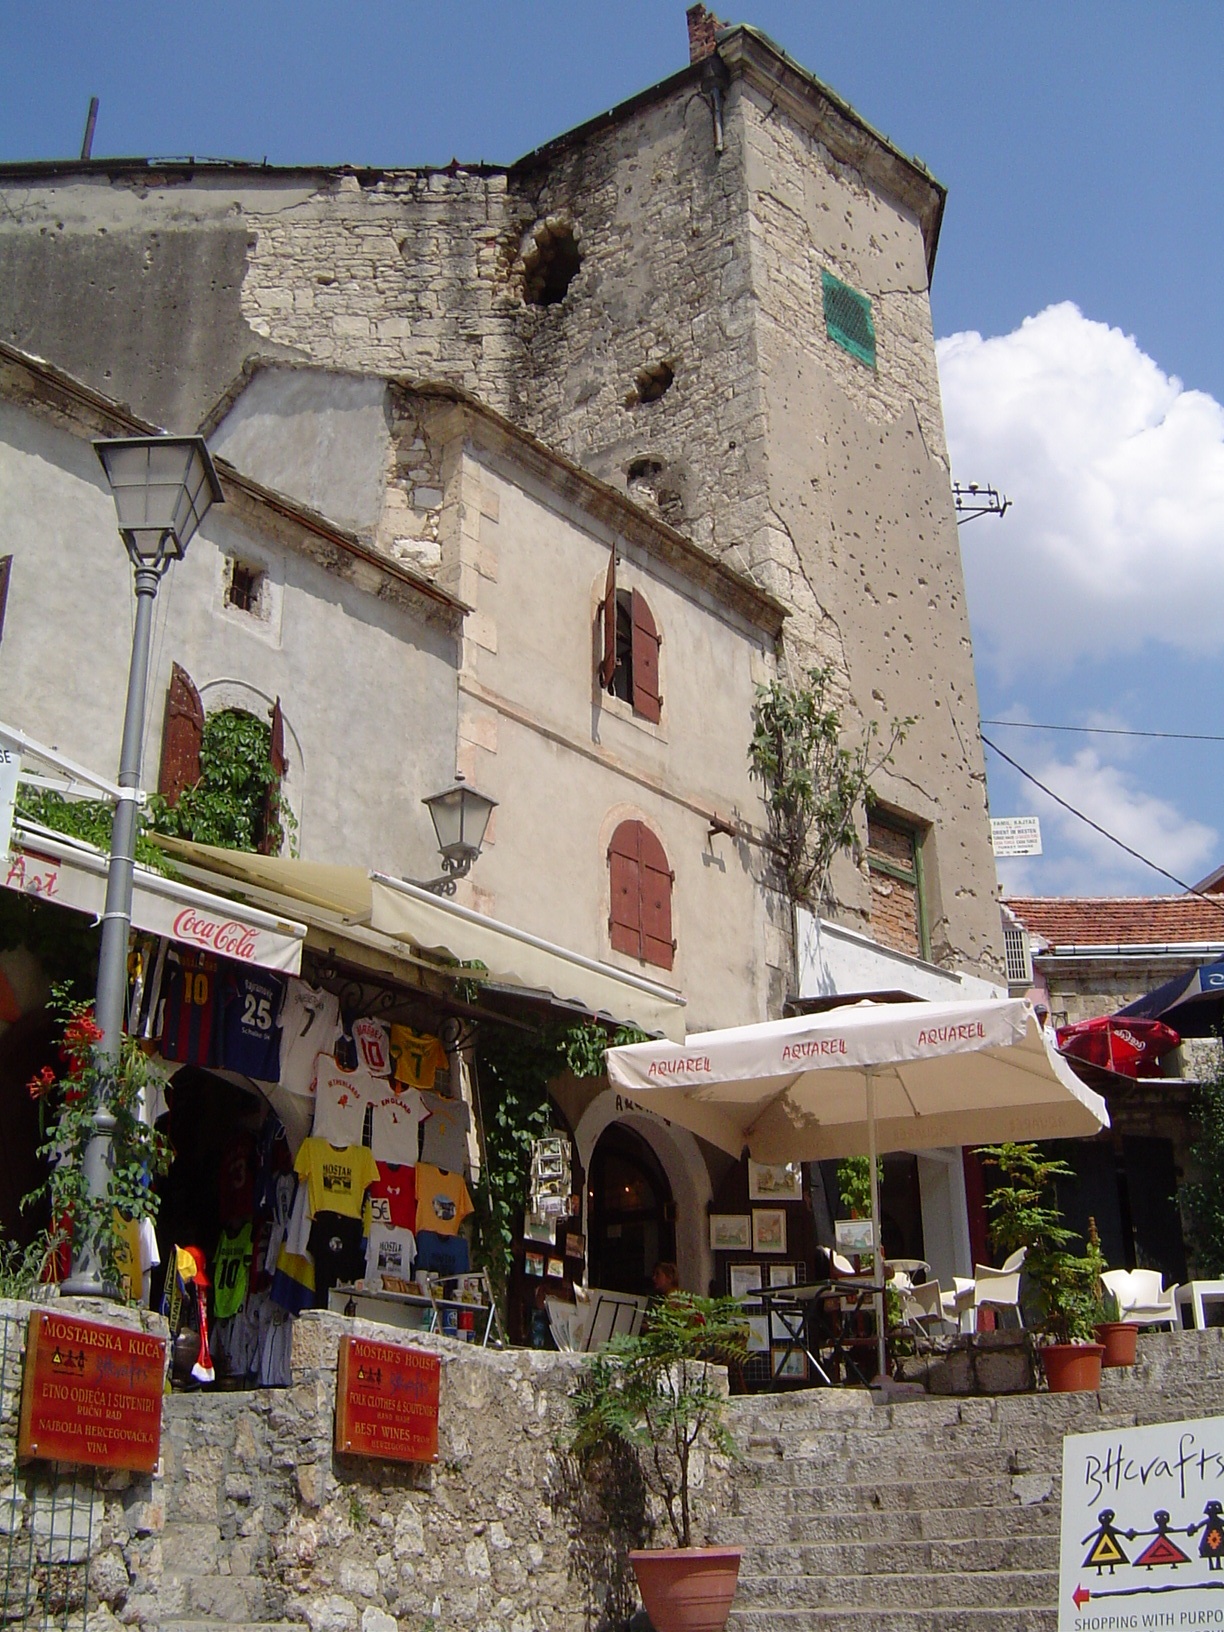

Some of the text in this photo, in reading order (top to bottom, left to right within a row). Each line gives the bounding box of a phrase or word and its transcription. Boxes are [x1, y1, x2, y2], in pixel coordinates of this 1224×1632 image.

[173, 908, 260, 959] Coca-Cola
[184, 971, 209, 1006] 10
[240, 993, 273, 1030] 25
[299, 1006, 316, 1038] 7
[917, 1022, 986, 1046] AQUARELL
[361, 1037, 385, 1068] 10
[782, 1038, 848, 1061] AQUARELL
[411, 1053, 423, 1079] 7
[648, 1056, 712, 1076] AQUARELL
[381, 1098, 412, 1115] ENGLAND
[323, 1164, 352, 1177] MOSTAR
[371, 1199, 390, 1221] 5€
[218, 1258, 241, 1290] 10
[44, 1321, 160, 1359] MOSTARSKA KUĆA
[355, 1344, 436, 1370] MOSTAR'S HOUSE
[42, 1383, 69, 1400] ETNO
[113, 1393, 155, 1413] SUVENIRI
[350, 1391, 367, 1406] FOLK
[367, 1395, 396, 1411] CLOTHES
[77, 1403, 122, 1420] RUČNI RAD
[85, 1424, 154, 1444] HERCEGOVAČKA
[355, 1421, 377, 1436] BEST
[381, 1425, 411, 1441] WINES
[87, 1441, 108, 1454] VINA
[1074, 1615, 1138, 1631] SHOPPING
[1142, 1612, 1174, 1627] WITH
